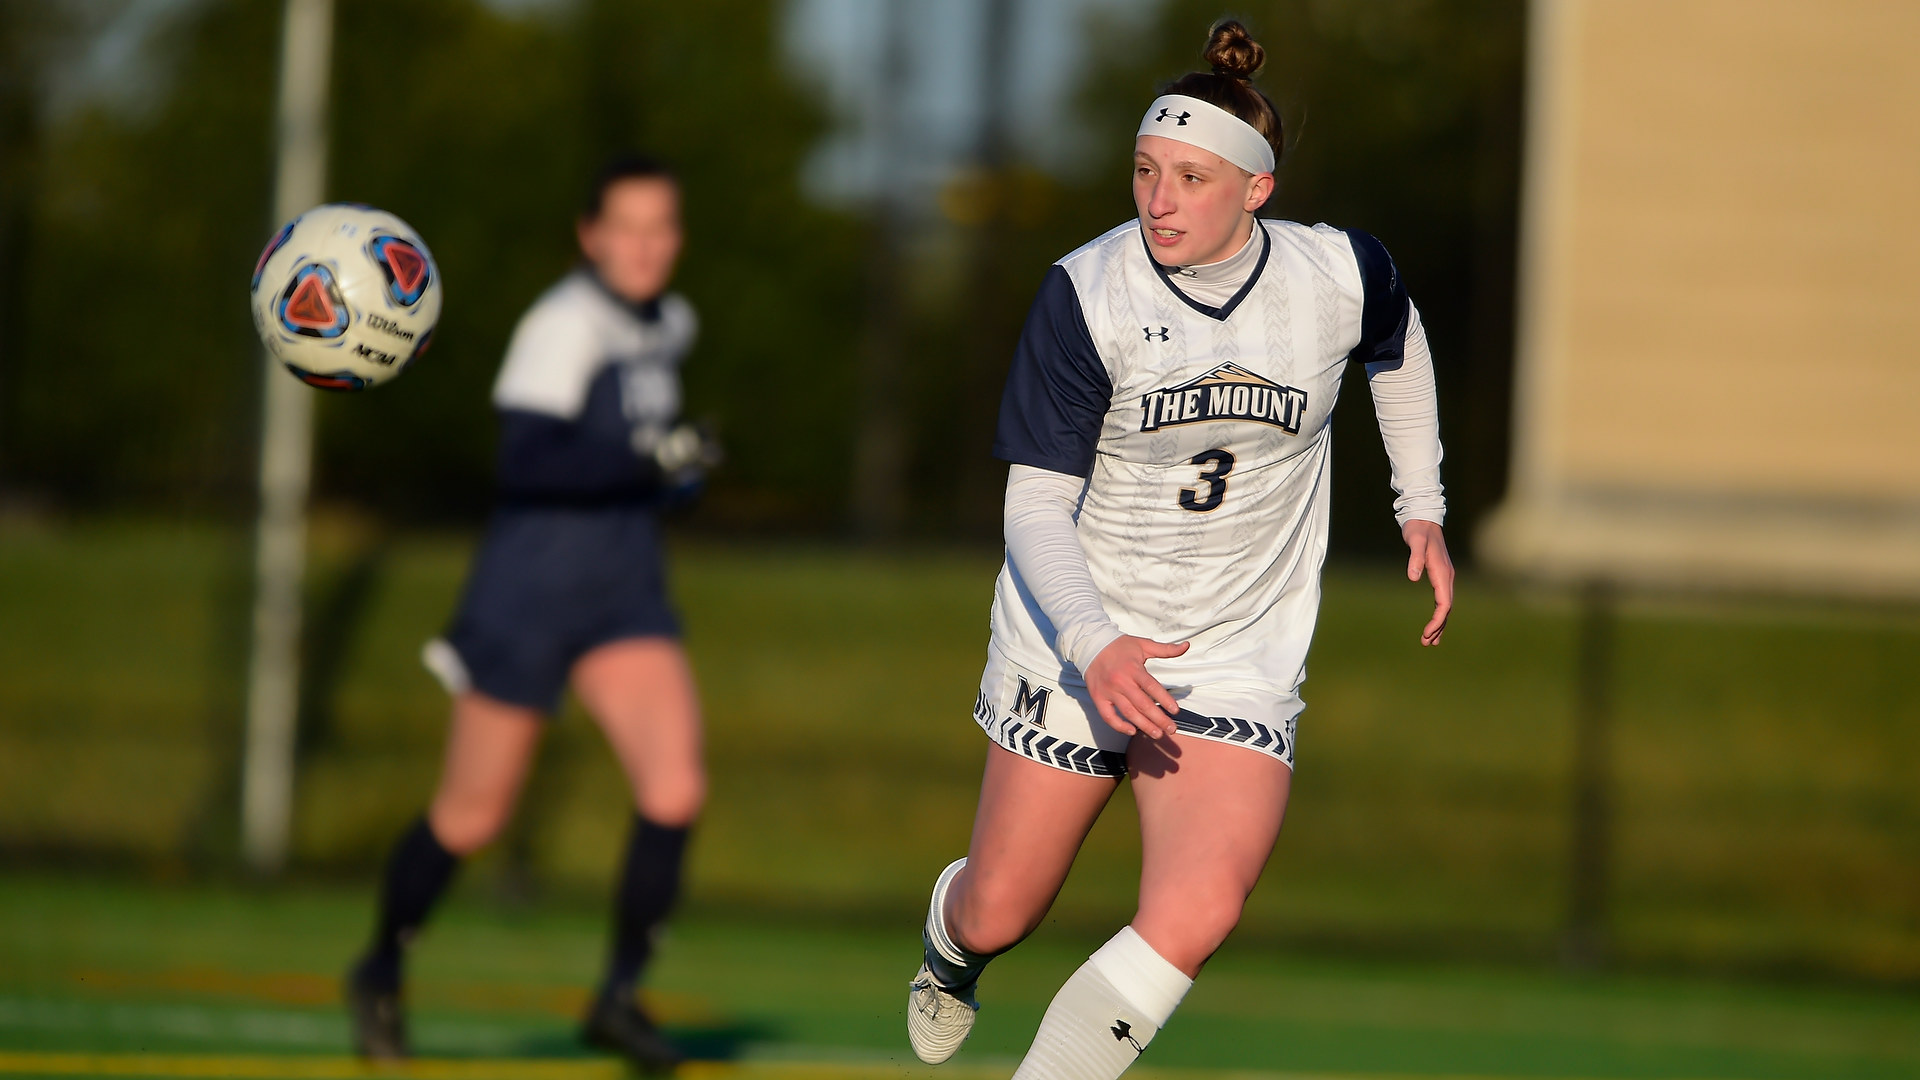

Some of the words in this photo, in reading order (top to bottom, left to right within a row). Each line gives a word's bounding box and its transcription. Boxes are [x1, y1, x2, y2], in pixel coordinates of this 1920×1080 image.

[367, 313, 414, 341] Wilson
[1145, 388, 1202, 428] THE
[1206, 385, 1305, 430] MOUNT
[1177, 448, 1237, 514] 3
[1010, 674, 1053, 730] M
